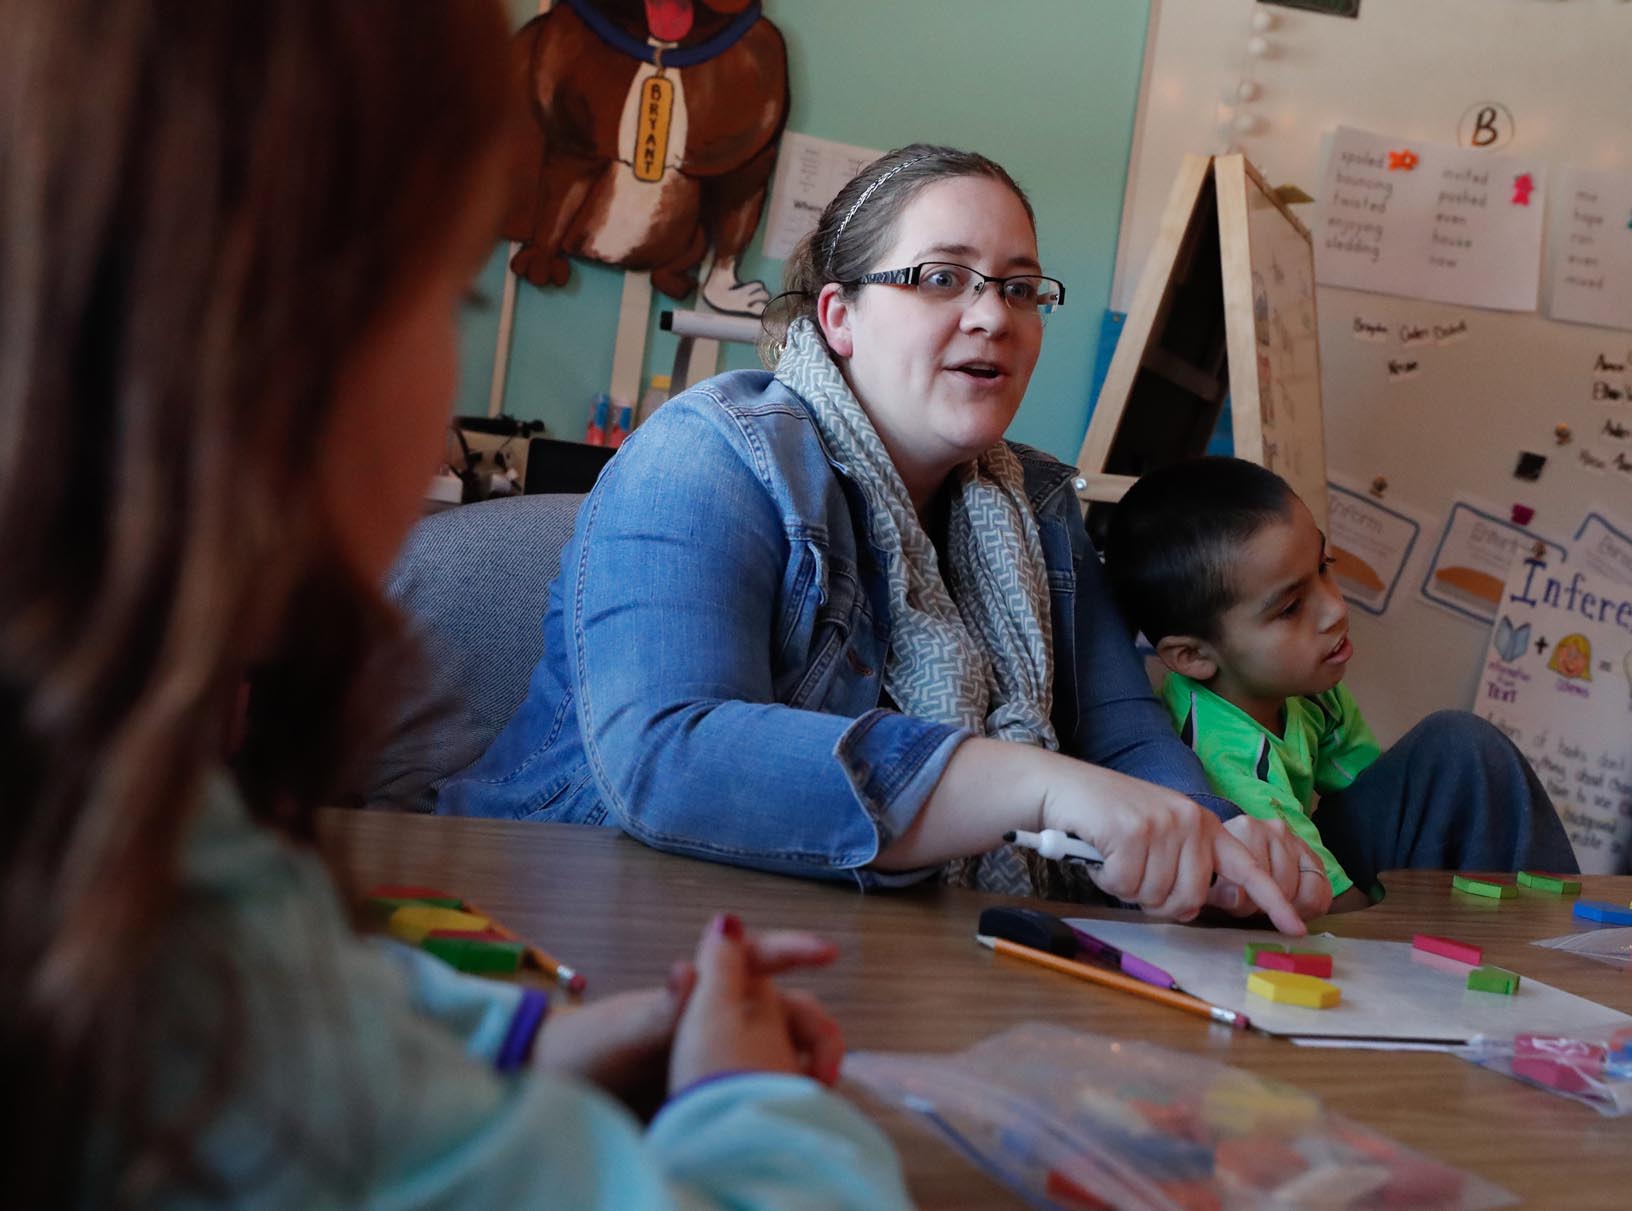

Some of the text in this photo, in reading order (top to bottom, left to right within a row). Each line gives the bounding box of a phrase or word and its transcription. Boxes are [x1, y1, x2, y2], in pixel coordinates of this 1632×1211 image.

[645, 84, 663, 174] BRYANT
[1471, 106, 1498, 147] B
[1510, 557, 1632, 632] Infere
